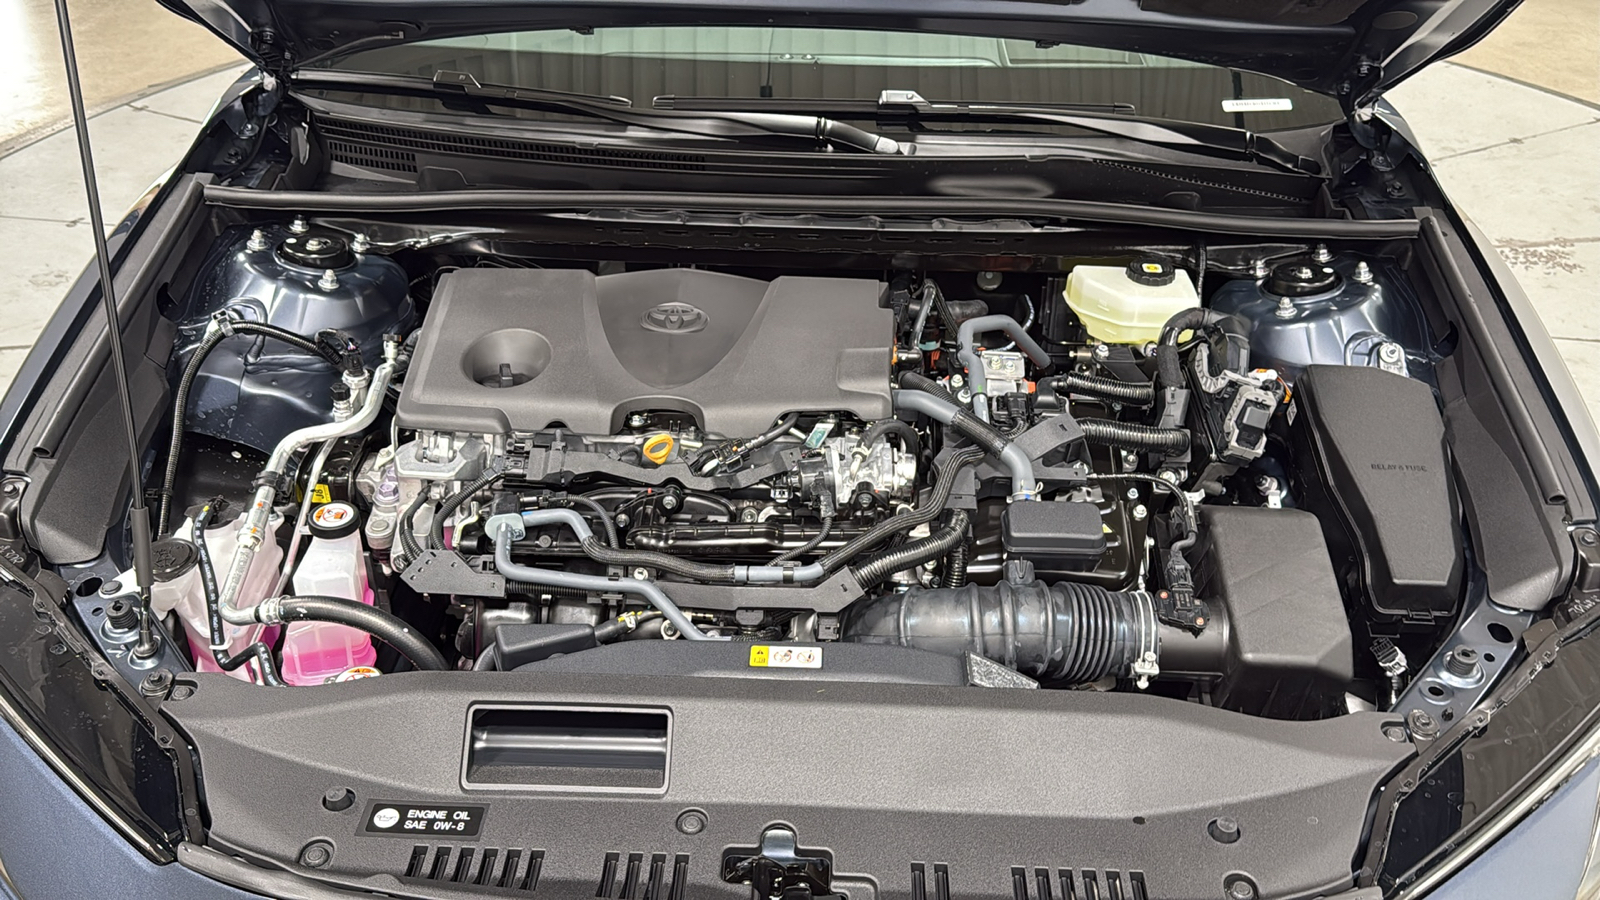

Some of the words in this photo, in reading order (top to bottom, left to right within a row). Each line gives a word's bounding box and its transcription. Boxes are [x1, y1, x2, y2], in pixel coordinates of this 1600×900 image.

[407, 809, 448, 819] ENGINE
[453, 811, 471, 820] OIL
[404, 820, 427, 829] SAE
[433, 821, 465, 831] 0W-8
